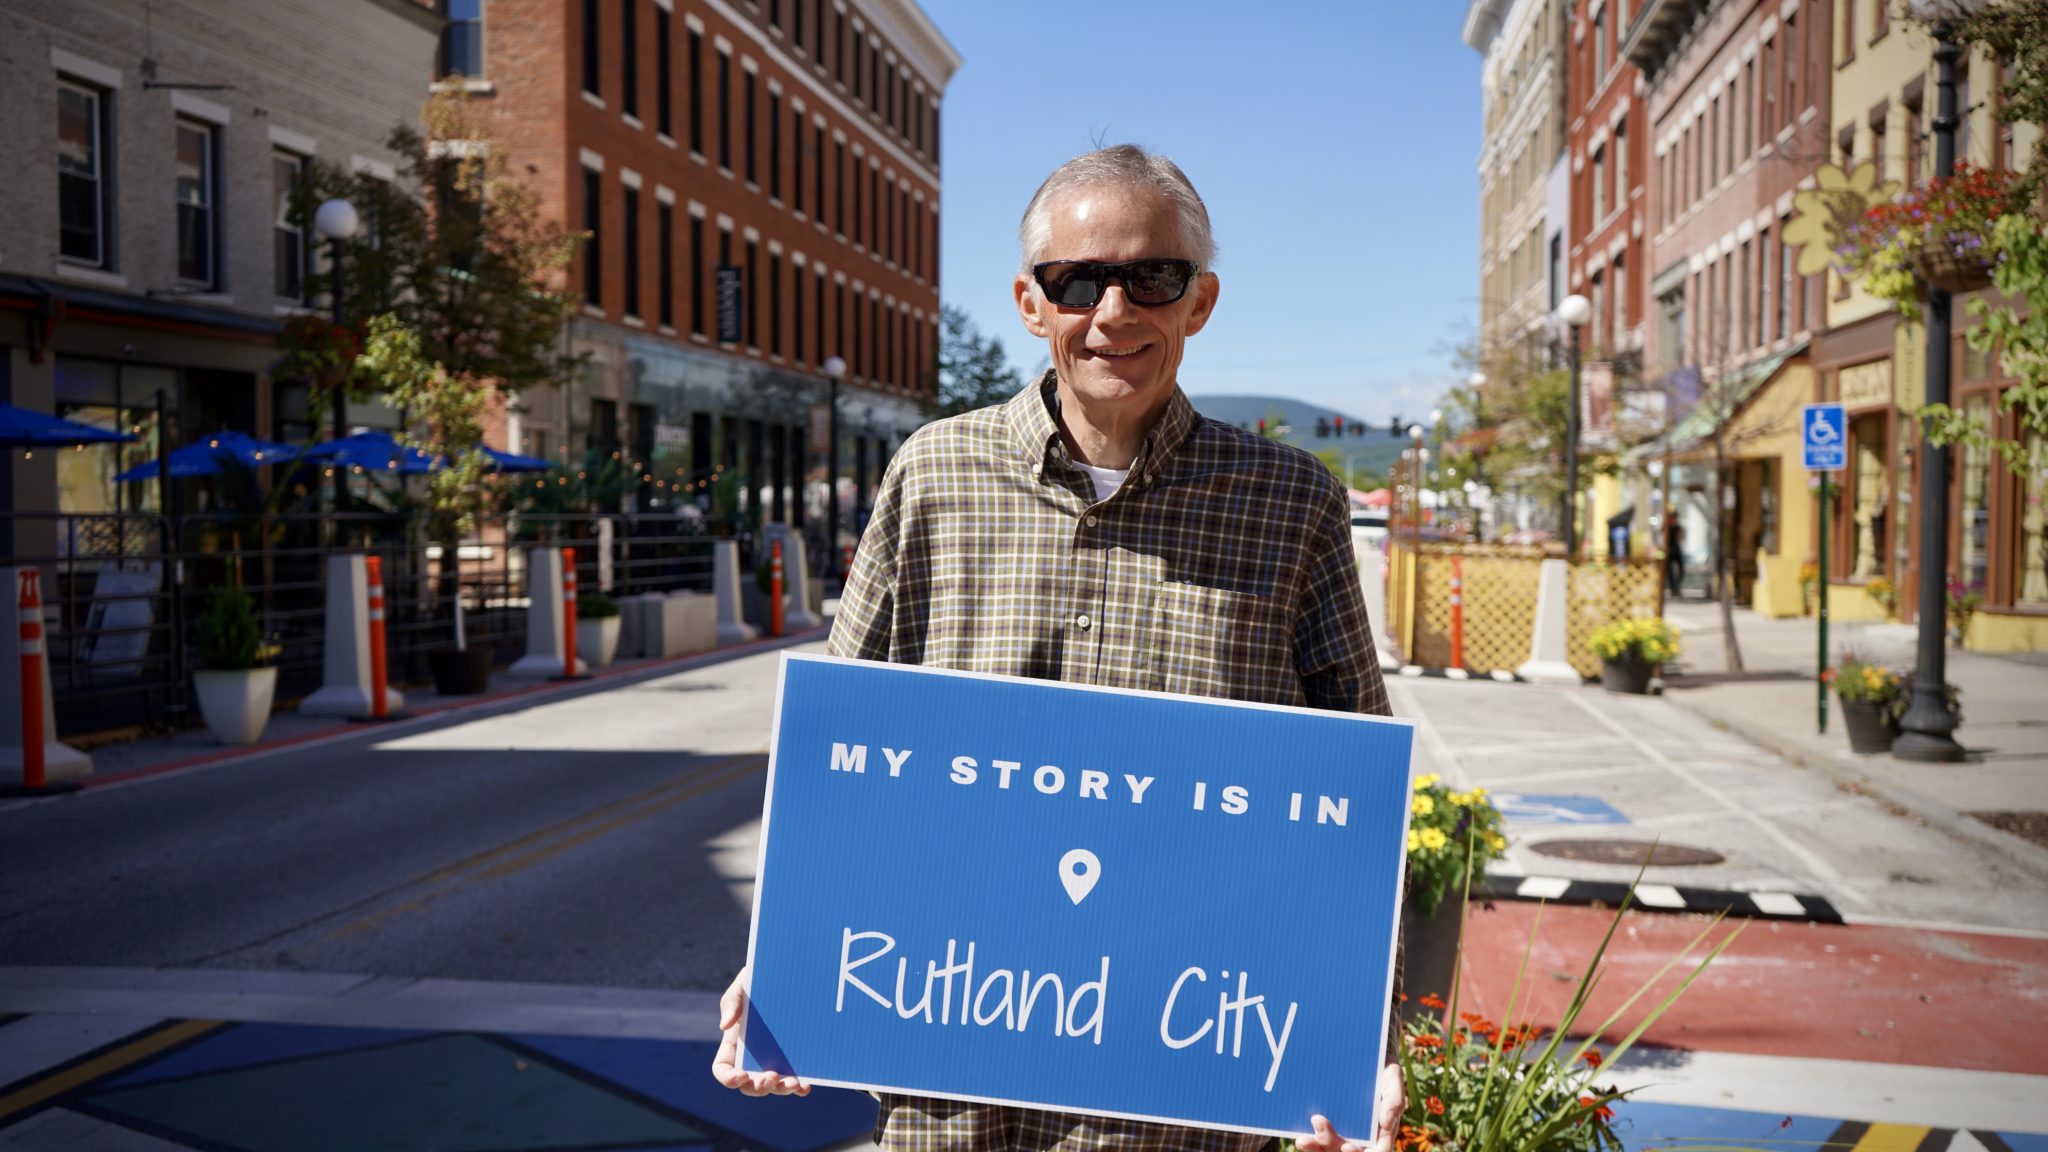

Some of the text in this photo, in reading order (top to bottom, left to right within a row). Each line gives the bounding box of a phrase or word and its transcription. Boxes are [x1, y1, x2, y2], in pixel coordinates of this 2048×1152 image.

[830, 742, 1349, 827] MY STORY IS IN
[836, 927, 1298, 1093] Rutland City
